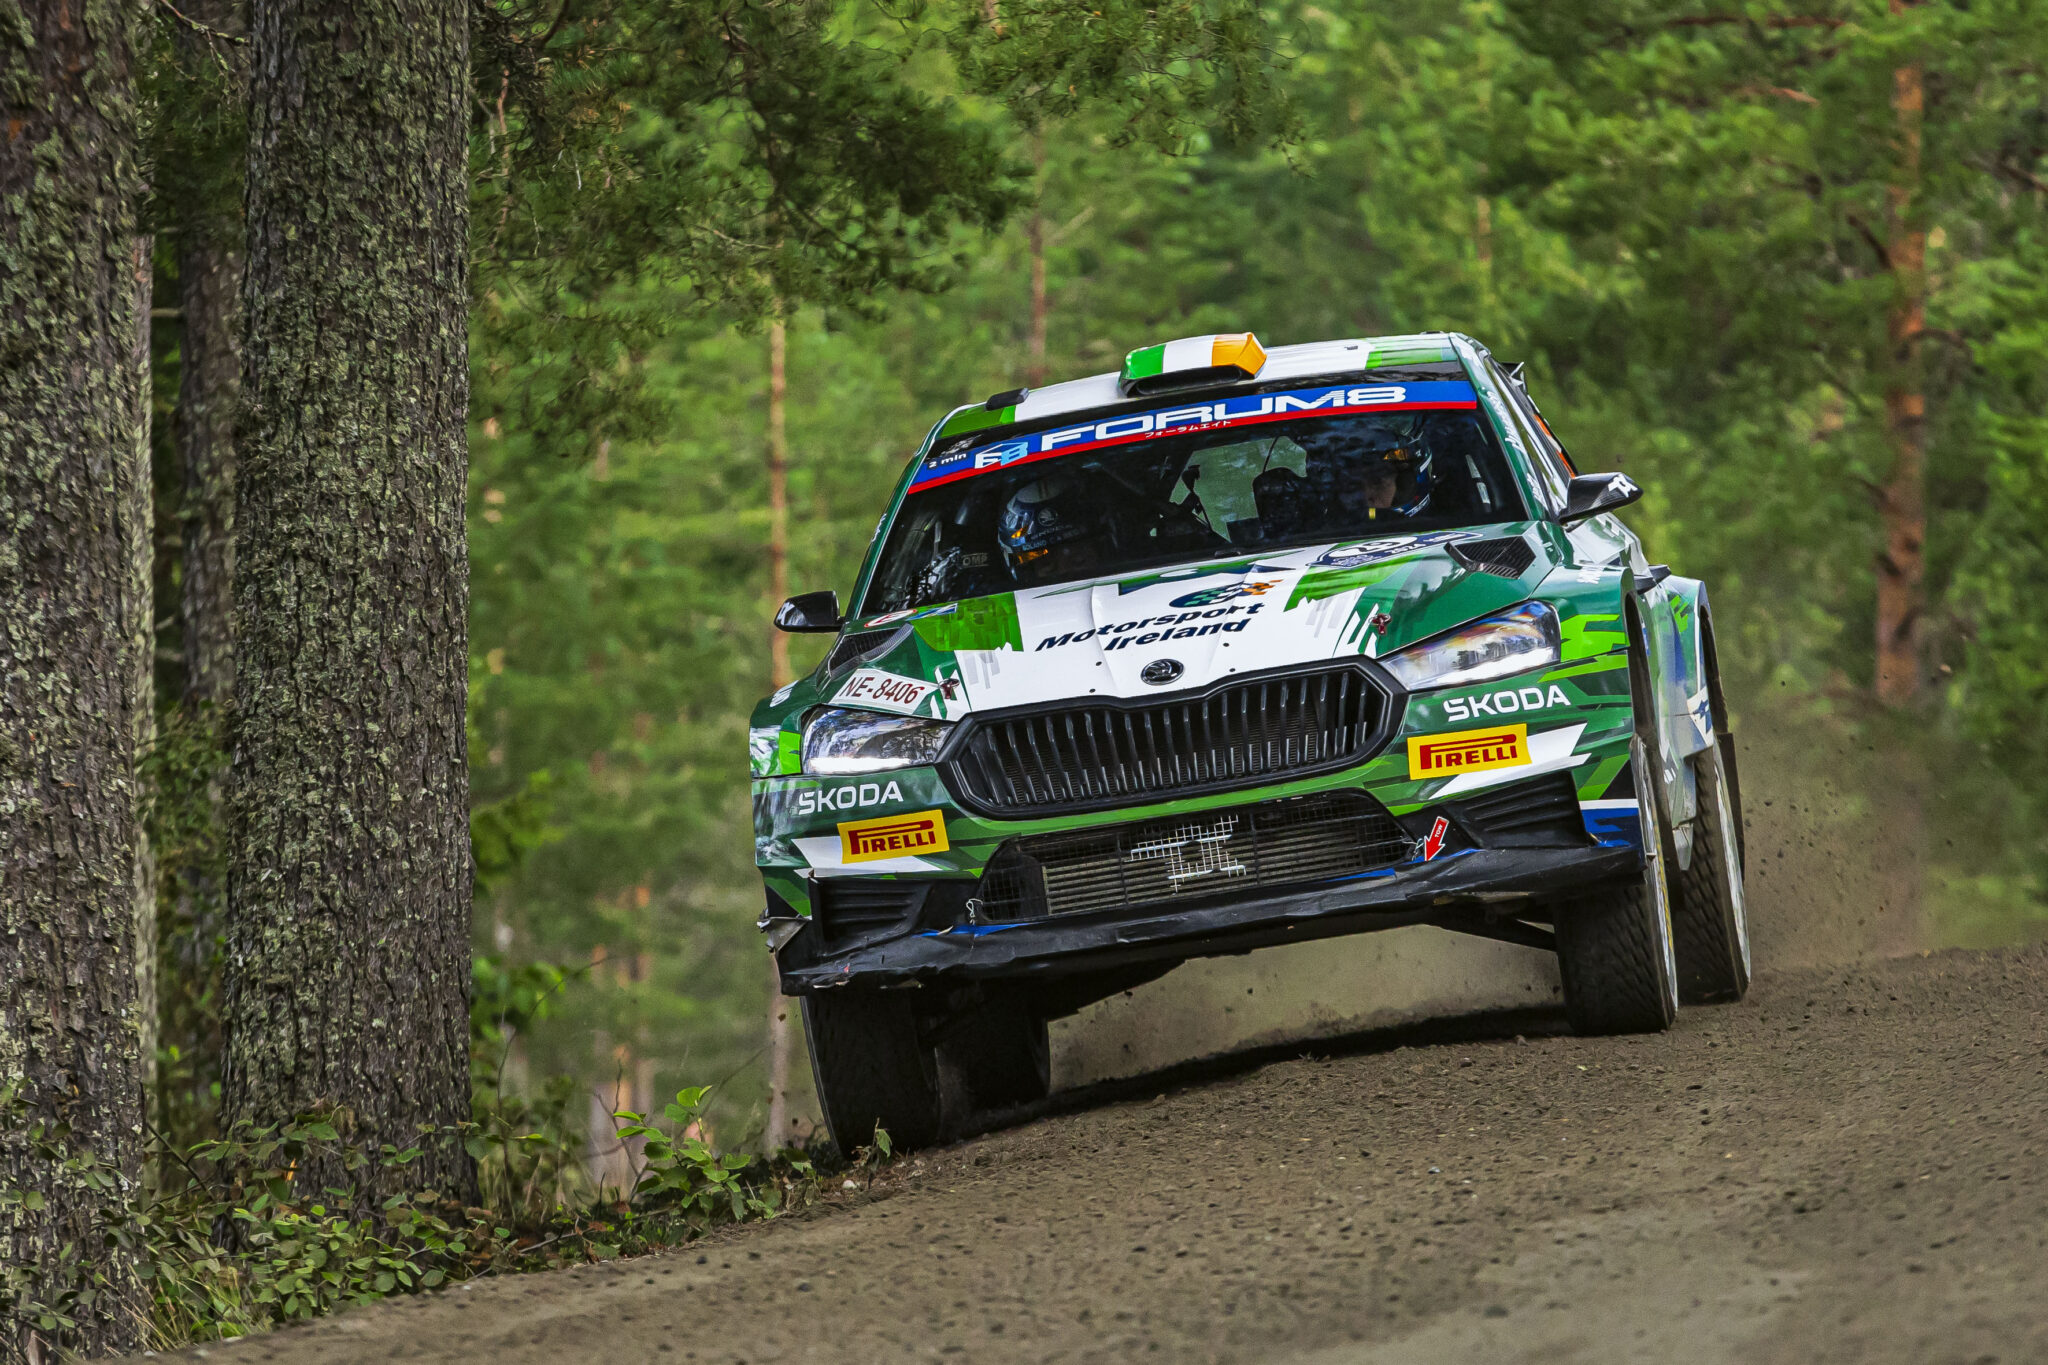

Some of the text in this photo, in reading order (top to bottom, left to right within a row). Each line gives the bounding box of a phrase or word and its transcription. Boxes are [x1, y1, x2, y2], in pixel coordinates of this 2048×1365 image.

[1041, 387, 1406, 452] FORUM8
[928, 461, 938, 469] 2
[1034, 602, 1265, 652] Motorsport
[1103, 617, 1252, 651] Ireland
[839, 676, 925, 704] NE-8406
[1419, 733, 1518, 770] PIRELLI
[848, 819, 937, 855] PIRELLI
[1434, 824, 1443, 838] TOW
